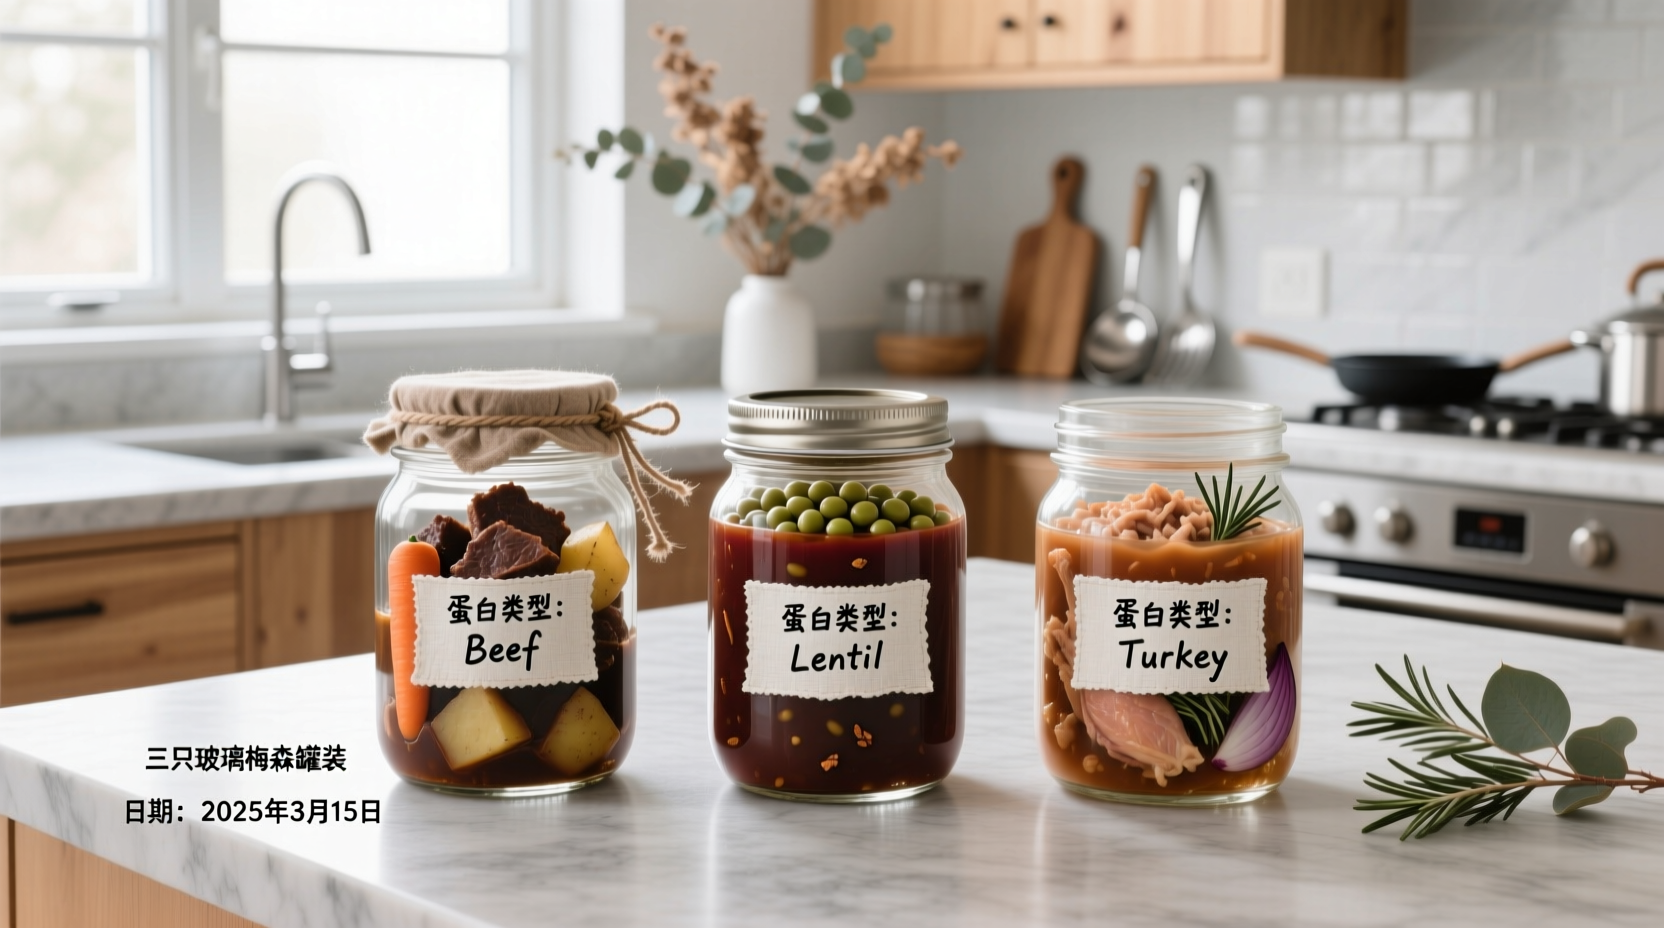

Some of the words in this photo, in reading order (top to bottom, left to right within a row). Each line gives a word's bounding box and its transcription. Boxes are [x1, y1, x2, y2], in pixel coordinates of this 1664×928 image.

[447, 592, 563, 625] 蛋白类型：
[781, 602, 898, 633] 蛋白类型：
[1113, 598, 1232, 630] 蛋白类型：
[464, 629, 543, 672] Beef
[790, 639, 884, 672] Lentil
[1118, 638, 1229, 683] Turkey
